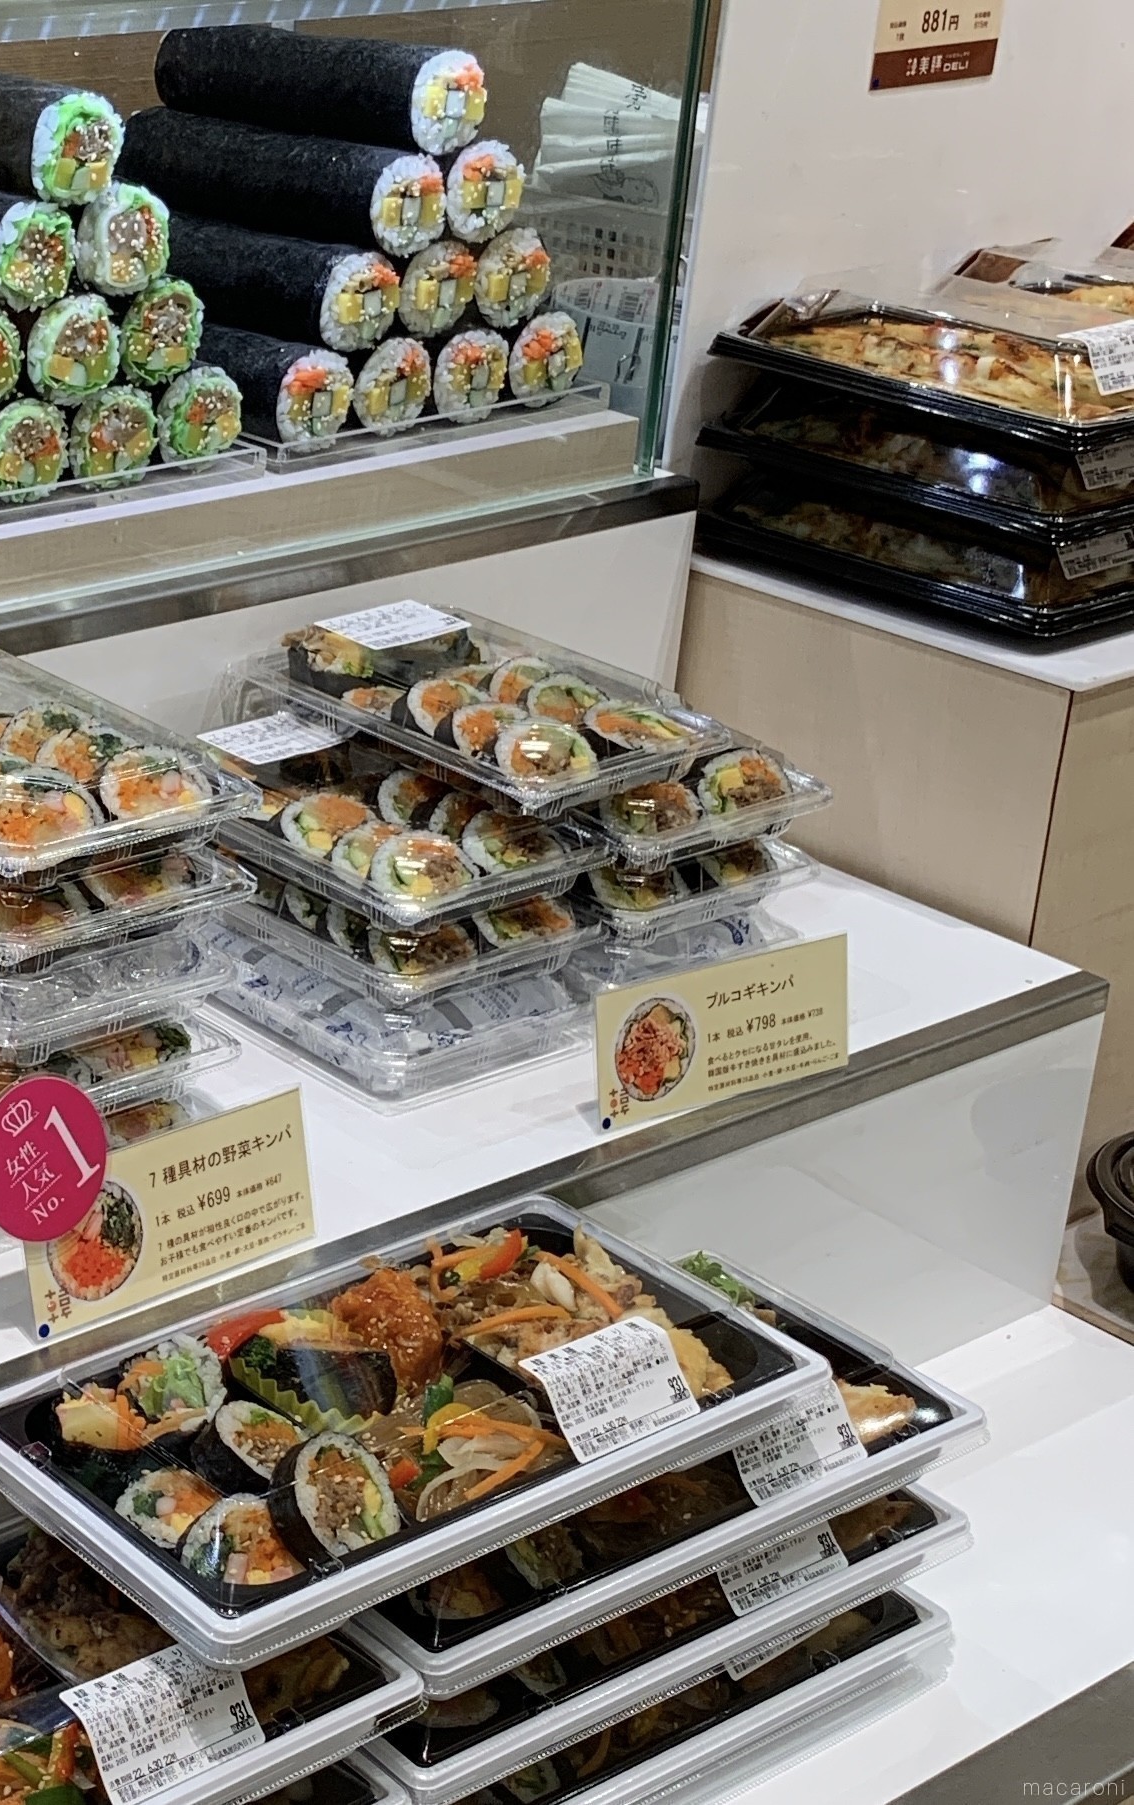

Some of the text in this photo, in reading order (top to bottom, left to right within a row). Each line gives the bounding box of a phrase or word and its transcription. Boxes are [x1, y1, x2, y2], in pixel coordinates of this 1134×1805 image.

[921, 9, 959, 34] 881円
[943, 61, 969, 72] DELI
[706, 974, 794, 1009] ブルコギキンパ
[746, 1013, 776, 1034] ¥798
[5, 1140, 40, 1181] 女性
[32, 1106, 101, 1226] No. 1
[22, 1162, 55, 1203] 人気
[197, 1186, 231, 1211] ¥699
[668, 1375, 686, 1394] 931
[229, 1700, 253, 1723] 931
